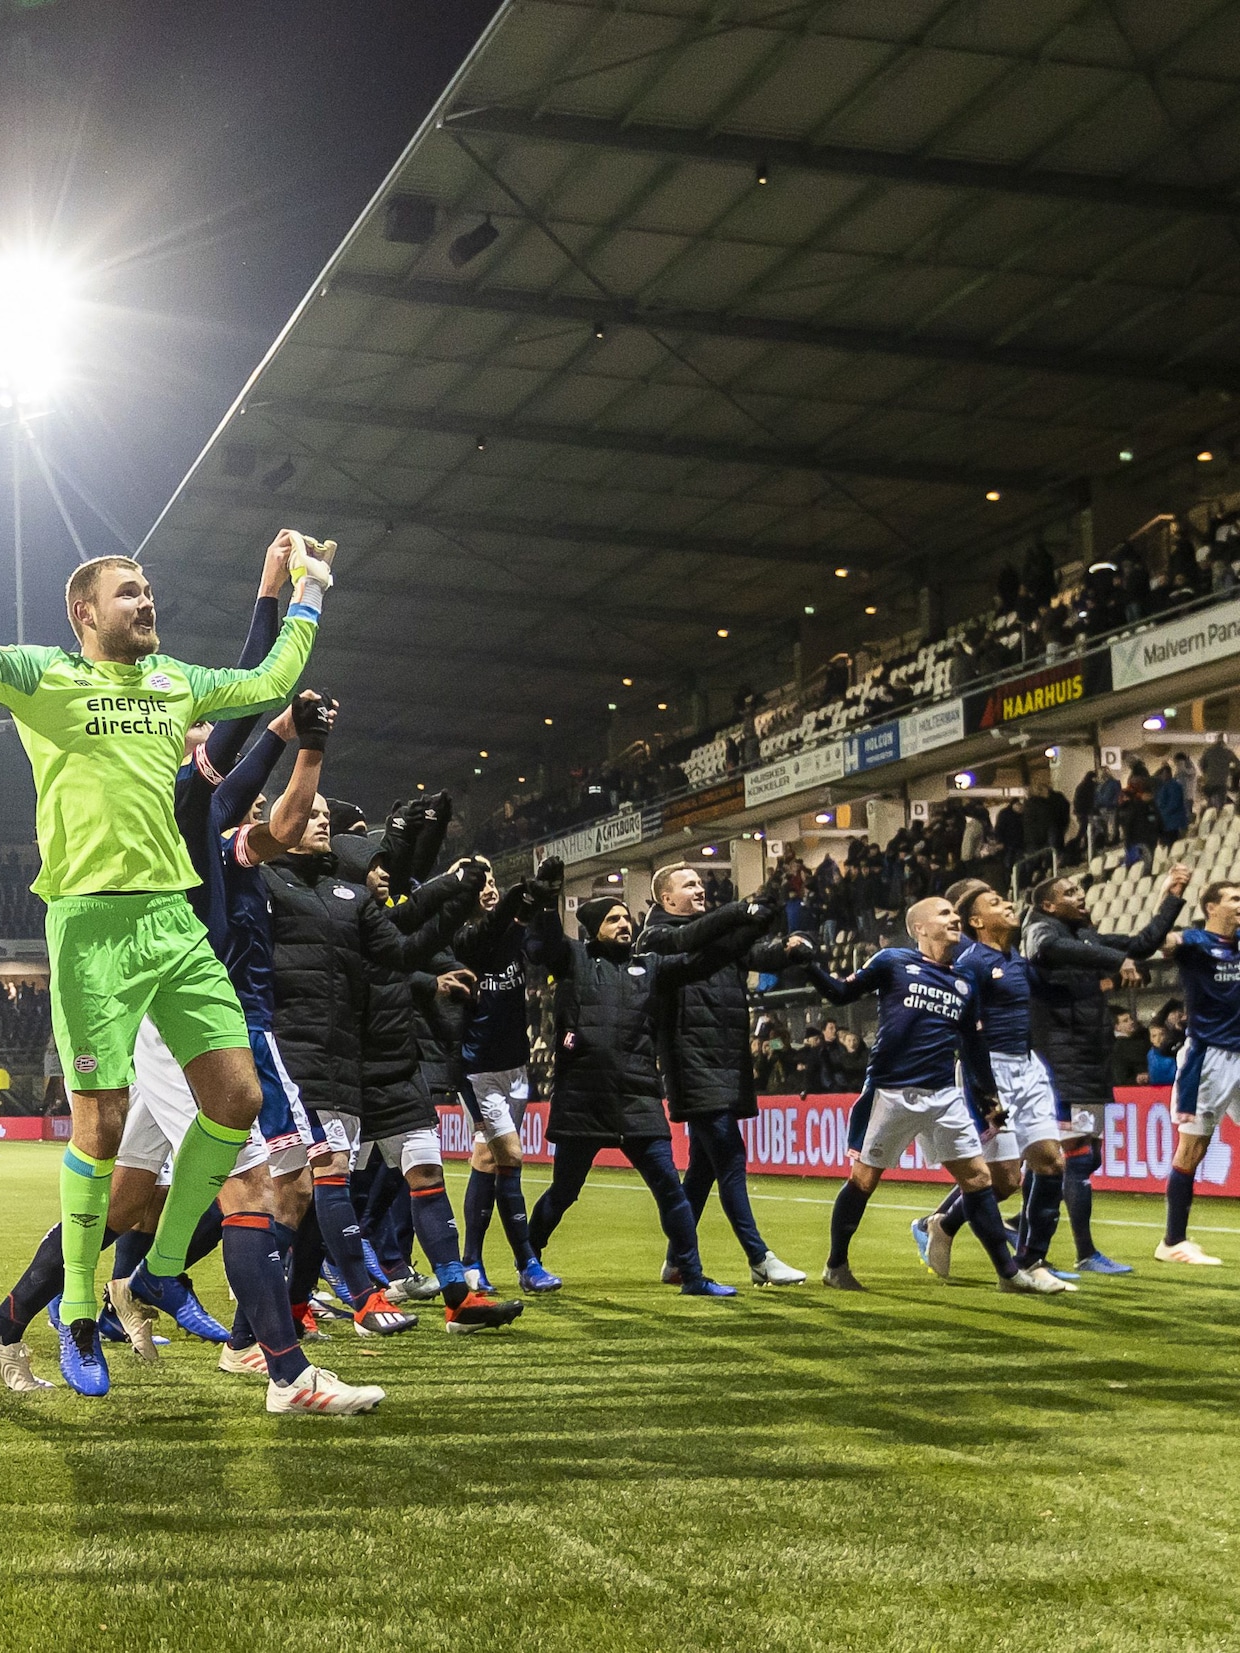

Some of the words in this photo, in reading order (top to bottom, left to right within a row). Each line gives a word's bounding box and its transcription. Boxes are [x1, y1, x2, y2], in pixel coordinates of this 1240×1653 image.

[1143, 633, 1205, 666] Malvern
[86, 695, 167, 715] energie
[1003, 674, 1083, 720] HAARHUIS
[85, 716, 173, 737] direct.nl
[1105, 751, 1116, 764] D
[914, 803, 924, 815] D
[770, 843, 780, 853] C
